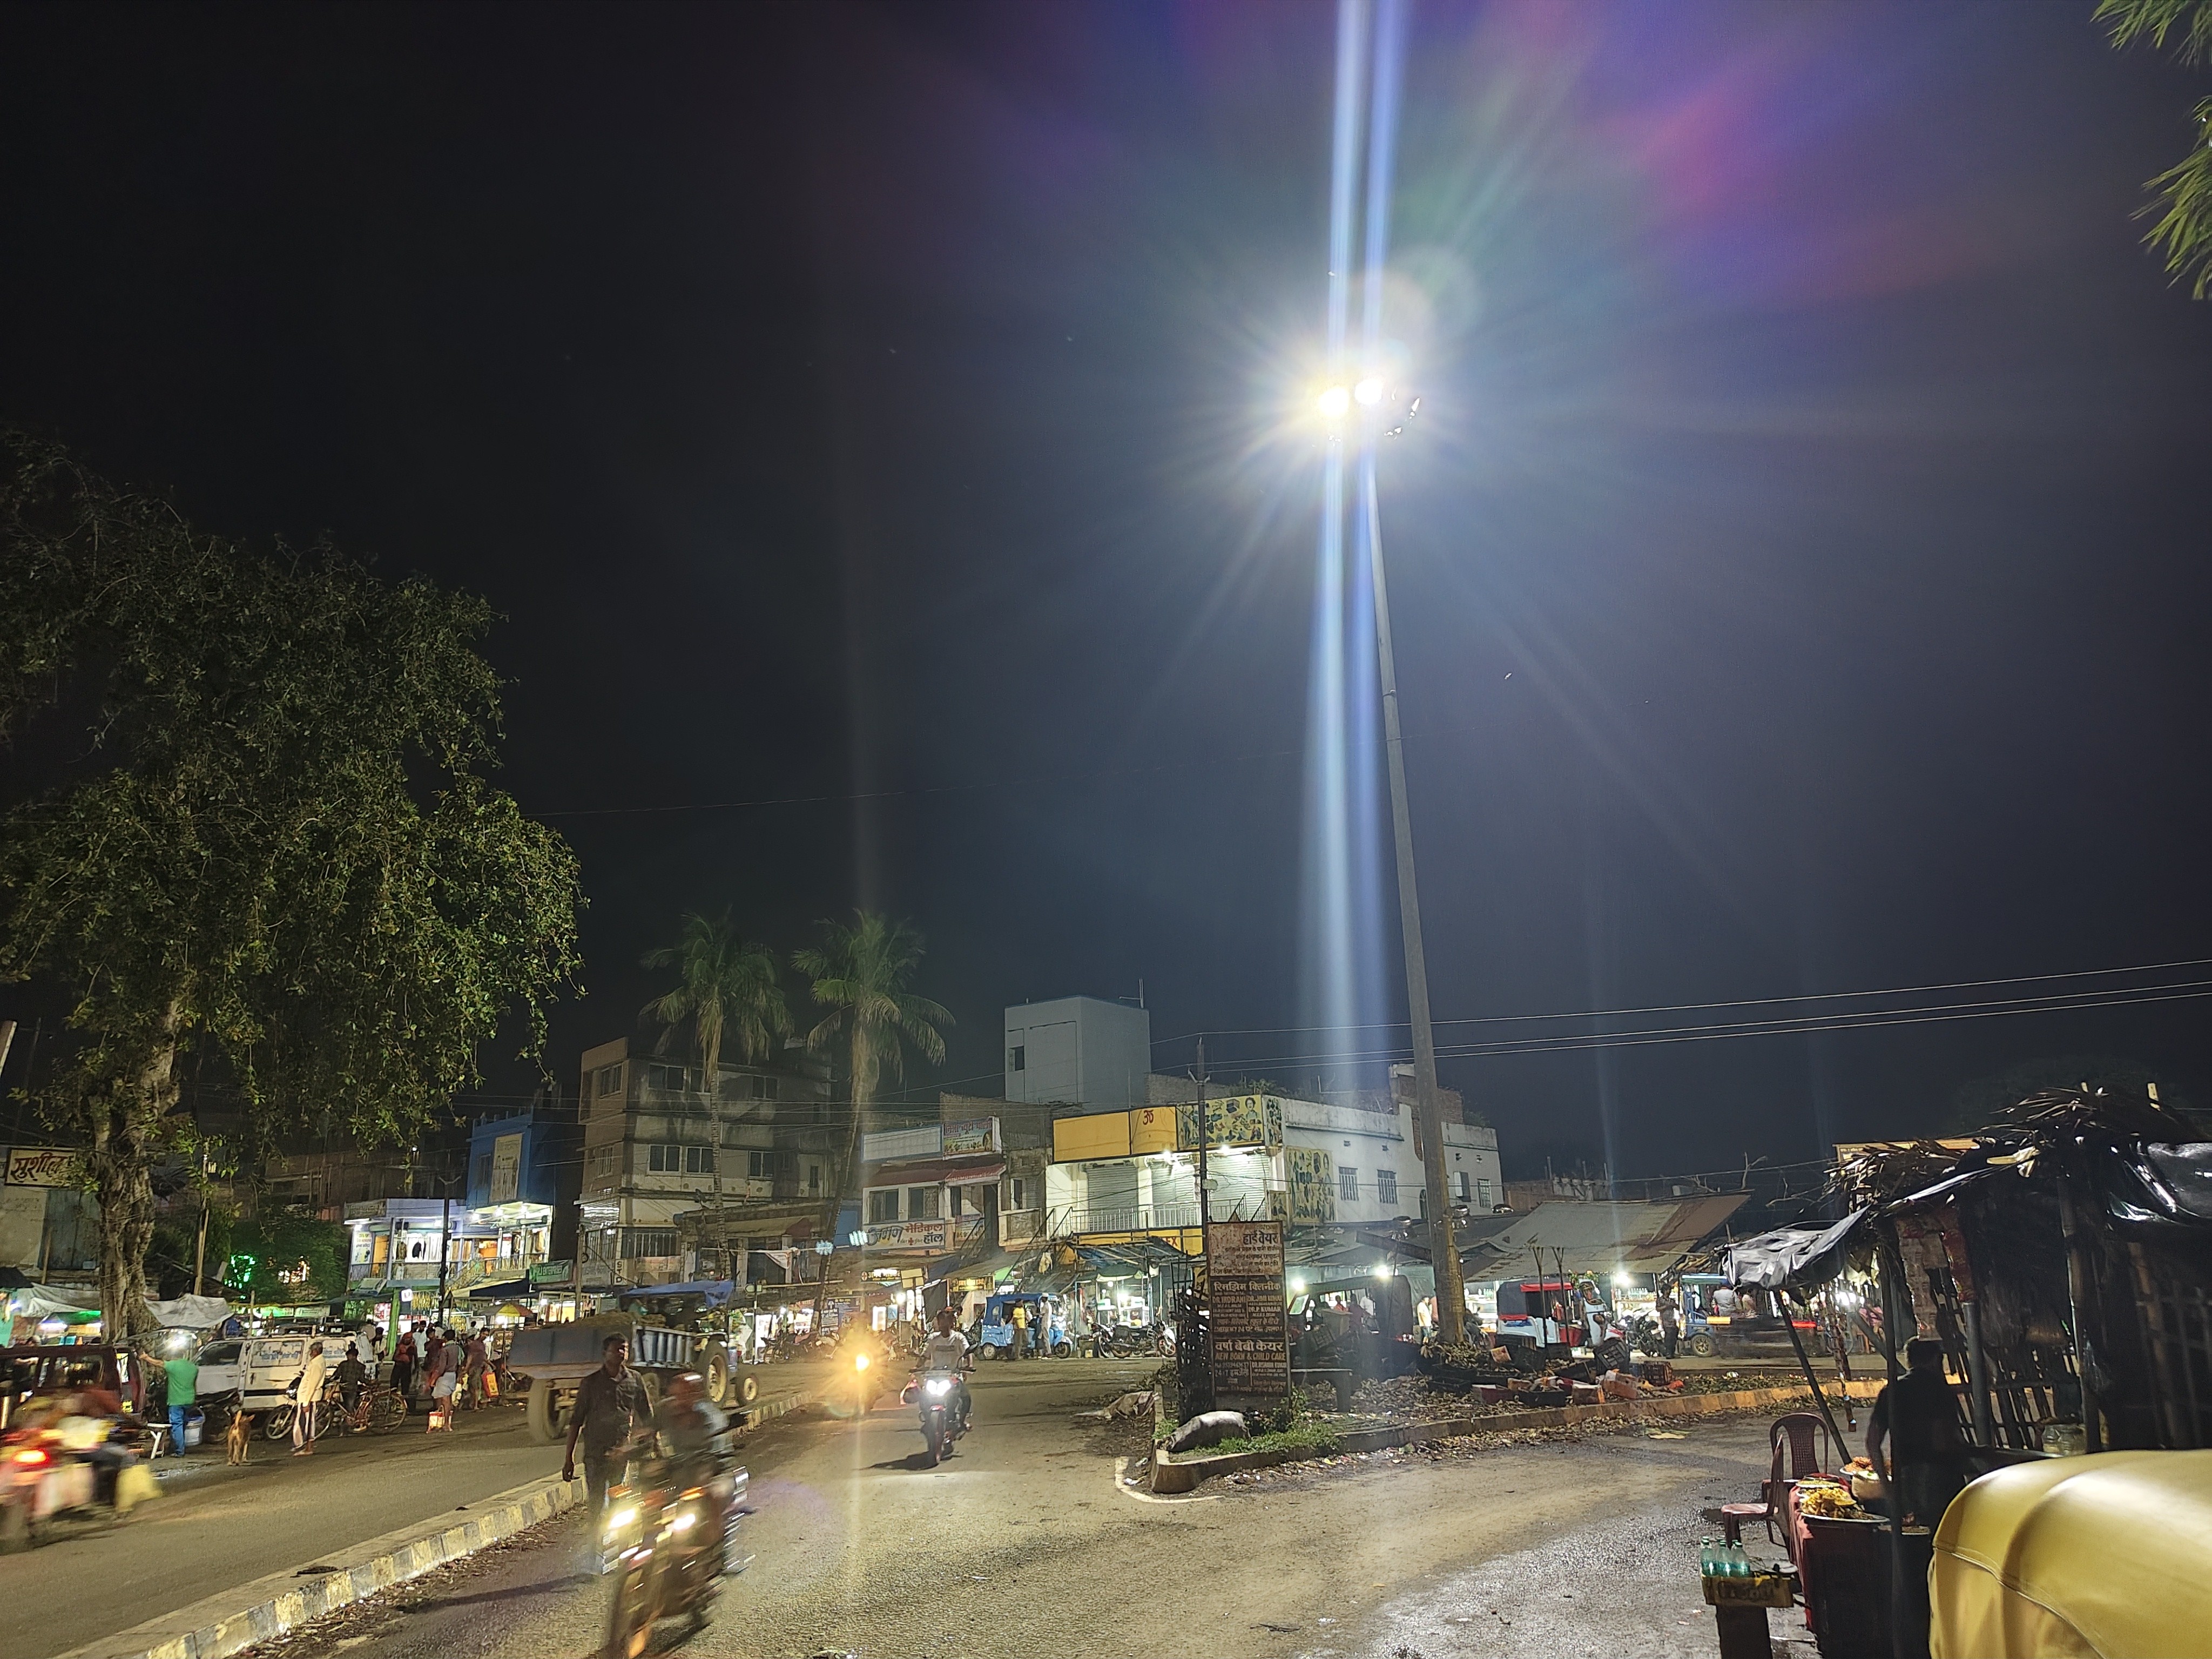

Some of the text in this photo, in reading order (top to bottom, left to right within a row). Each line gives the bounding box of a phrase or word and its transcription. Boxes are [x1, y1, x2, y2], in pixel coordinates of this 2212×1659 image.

[905, 1222, 943, 1233] मेडिकल
[923, 1232, 943, 1244] हॉल
[1215, 1339, 1284, 1351] वर्षा बेबी केयर
[1215, 1352, 1229, 1360] NEW
[1253, 1352, 1270, 1360] CHILD
[1271, 1352, 1286, 1360] CARE
